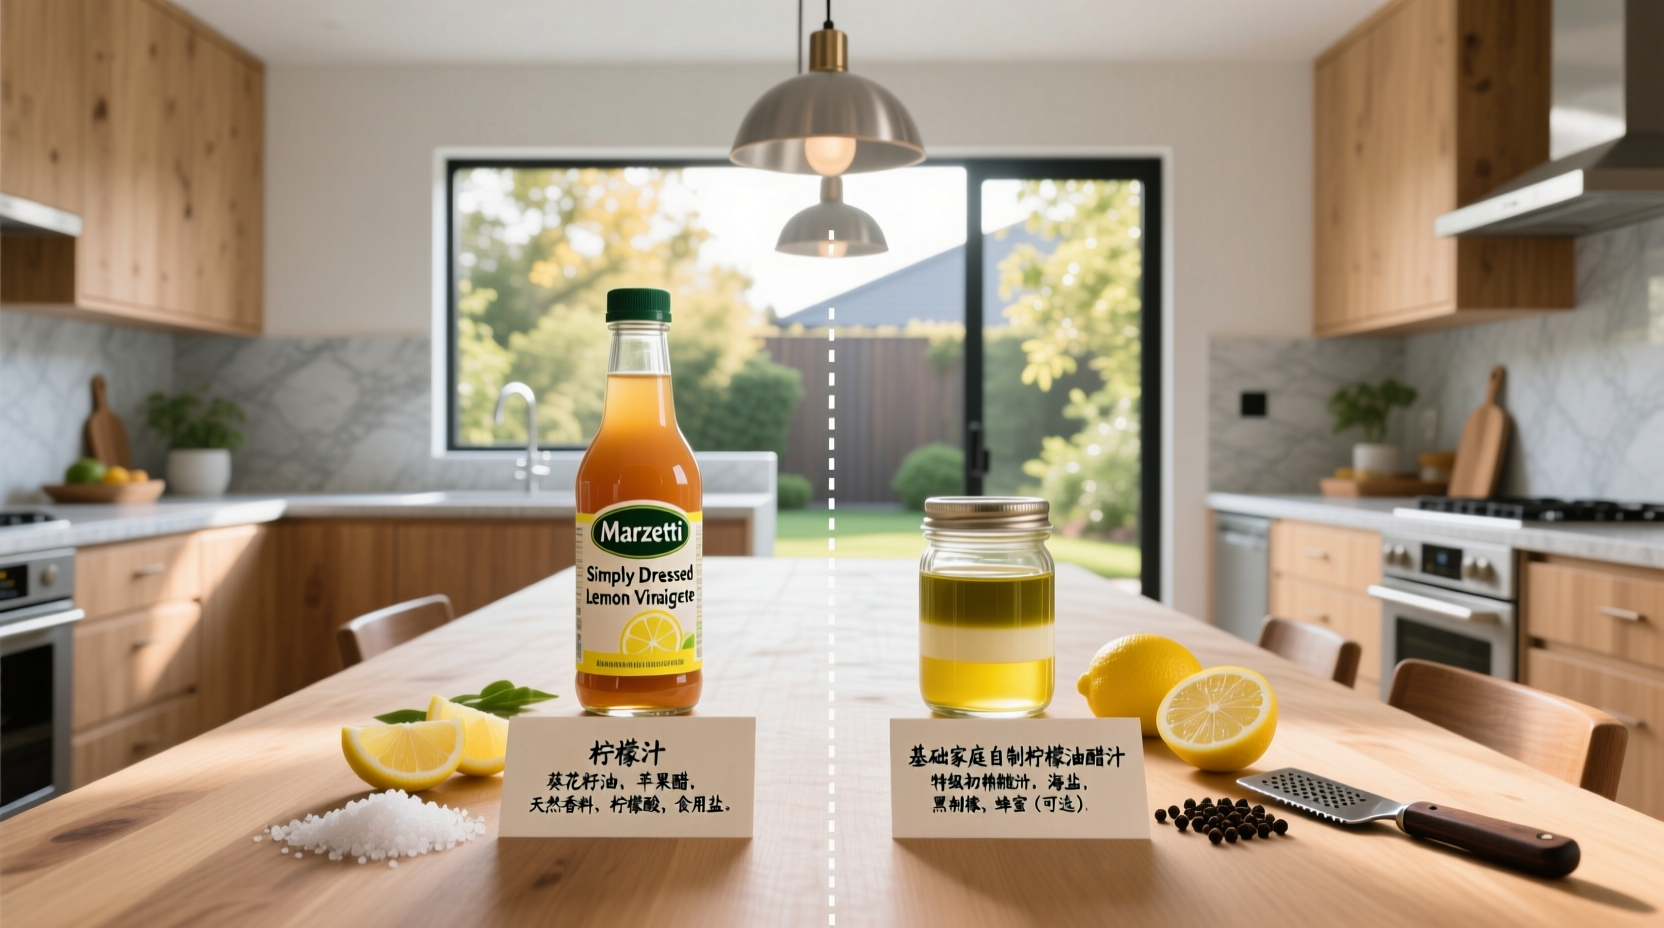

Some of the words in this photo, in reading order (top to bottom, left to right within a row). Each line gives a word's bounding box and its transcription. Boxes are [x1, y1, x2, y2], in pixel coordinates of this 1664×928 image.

[600, 520, 683, 543] Marzetti
[586, 565, 635, 587] Simply
[639, 564, 694, 583] Dressed
[586, 588, 630, 605] Lemon
[589, 738, 666, 767] 柠檬汁
[908, 744, 1126, 768] 基础家庭自制柠檬油醋汁
